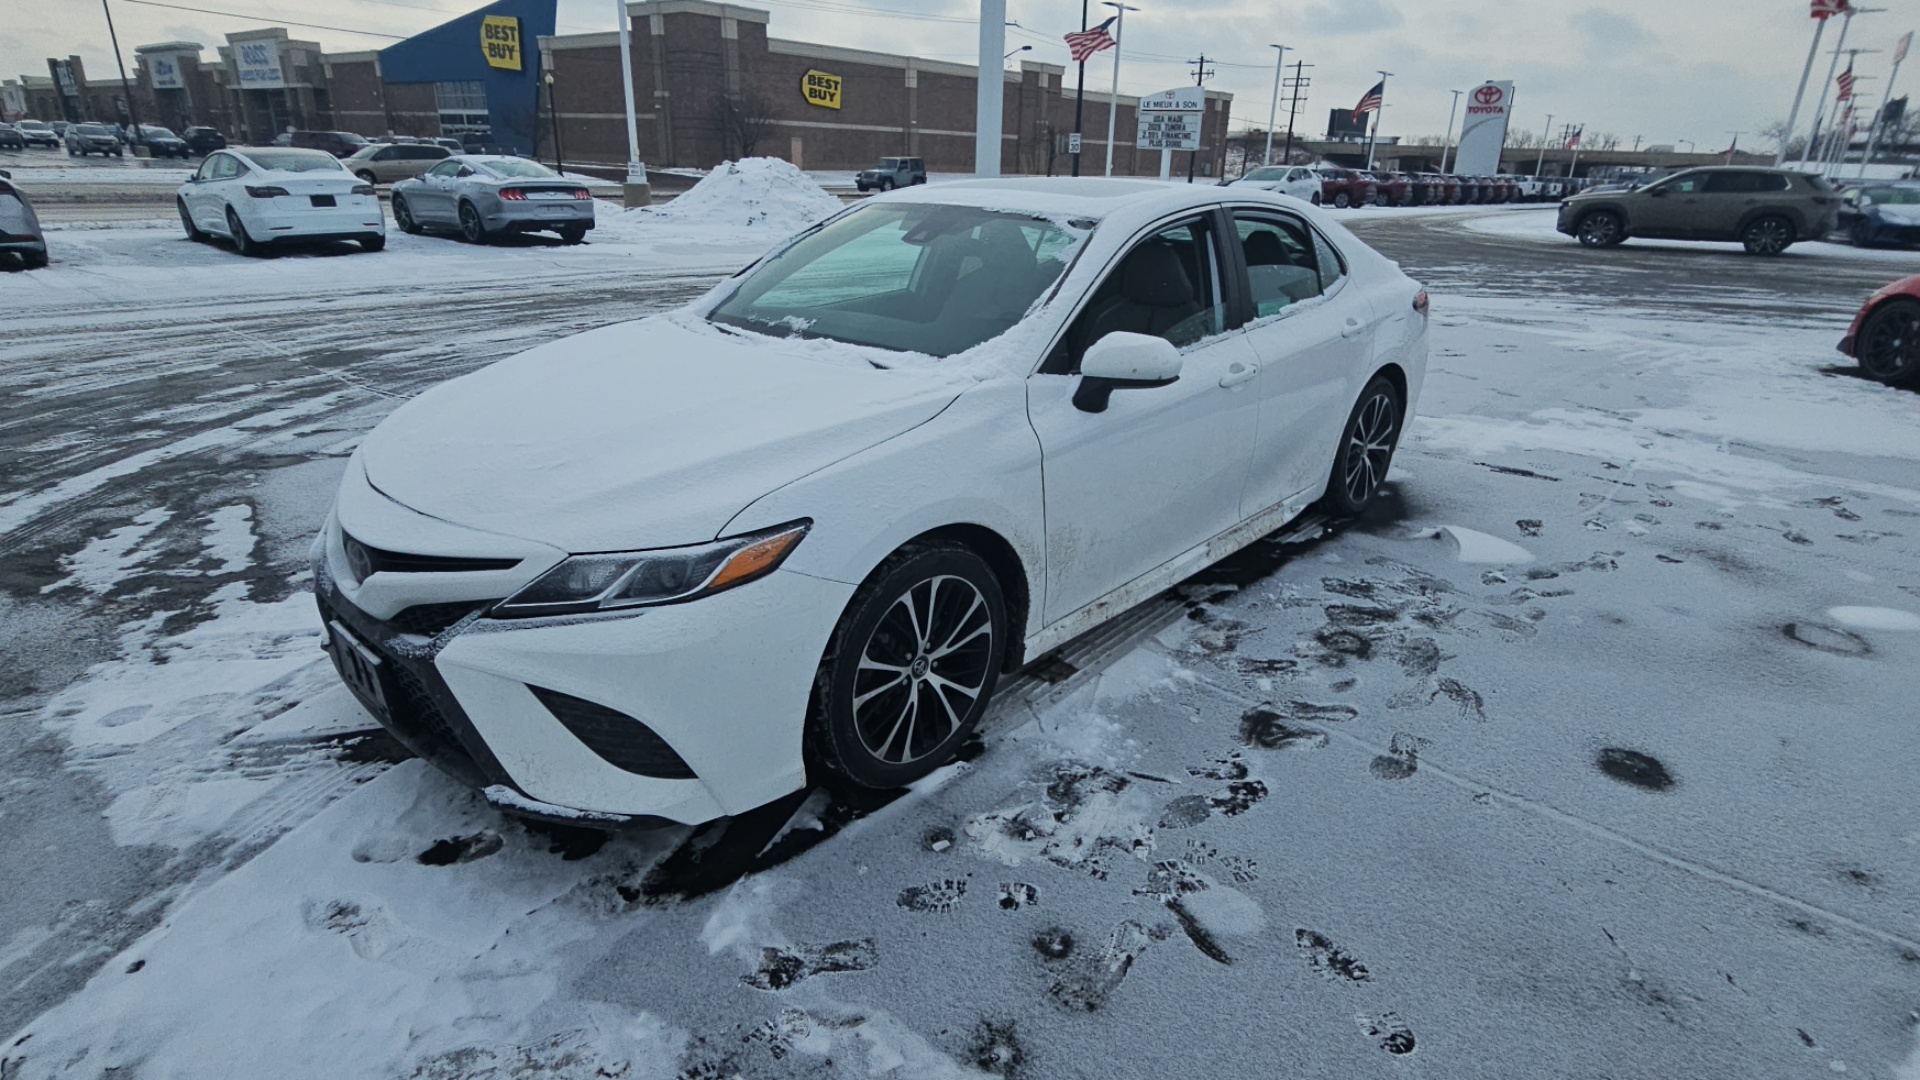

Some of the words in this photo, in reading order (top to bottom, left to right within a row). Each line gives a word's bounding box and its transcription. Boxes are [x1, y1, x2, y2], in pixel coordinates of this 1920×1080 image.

[485, 24, 516, 42] BEST
[488, 43, 515, 60] BUY
[808, 75, 839, 91] BEST
[809, 88, 836, 102] BUY
[1468, 106, 1504, 114] TOYOTA
